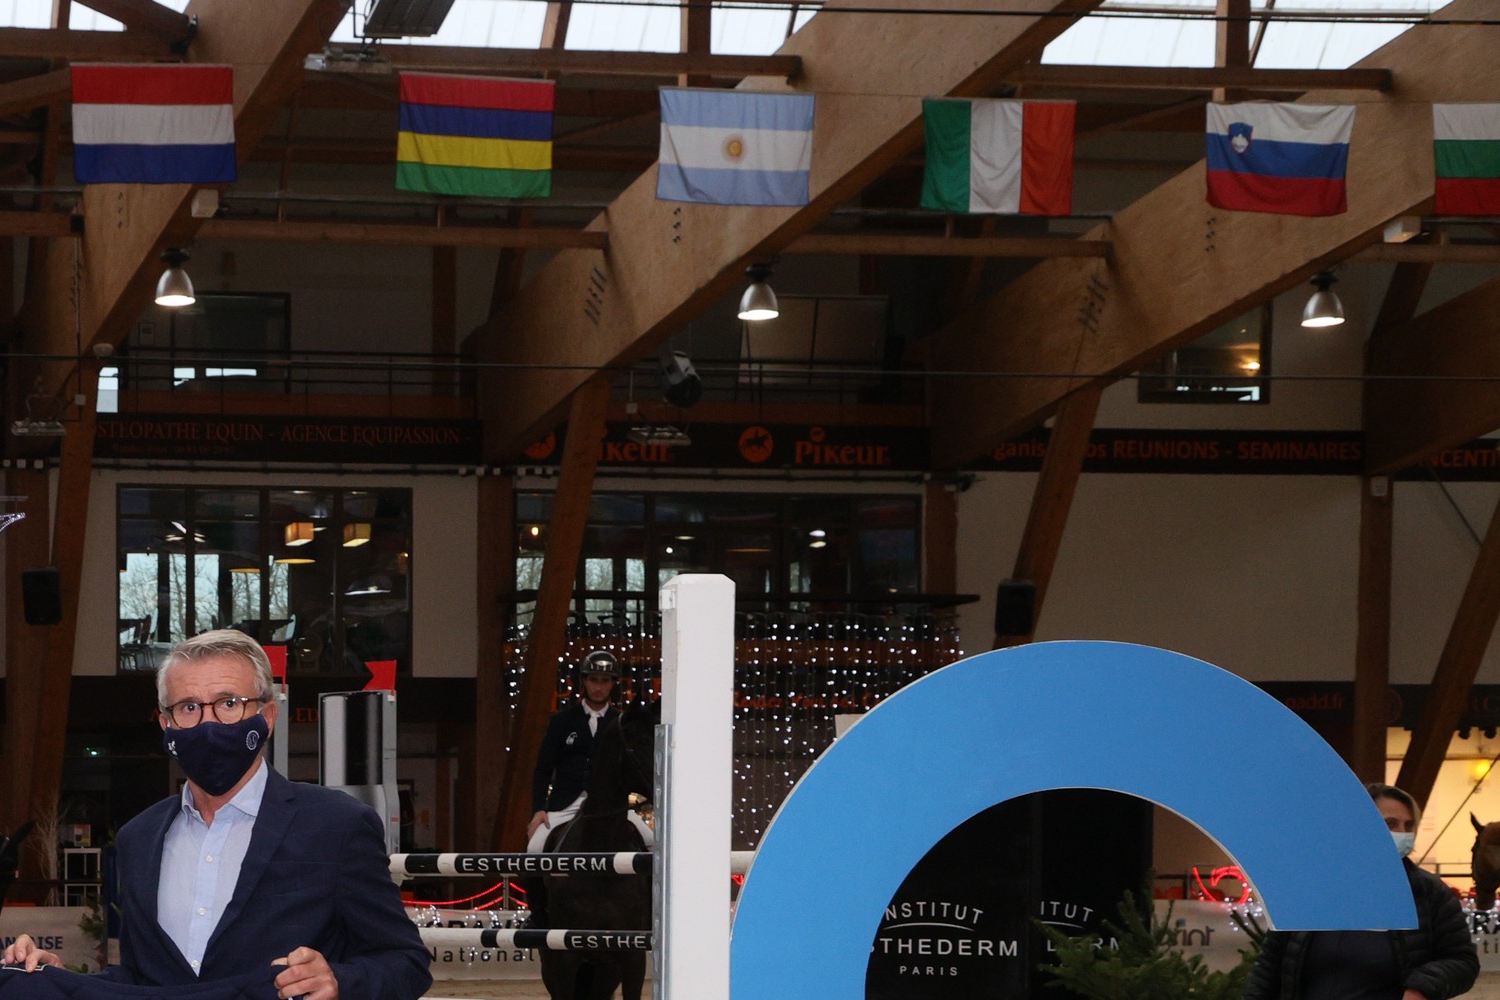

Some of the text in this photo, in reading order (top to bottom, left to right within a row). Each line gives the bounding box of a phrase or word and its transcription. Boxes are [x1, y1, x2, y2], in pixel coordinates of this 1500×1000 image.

[95, 421, 200, 441] STEOPATHE
[461, 856, 608, 872] ESTHEDERM
[884, 901, 984, 925] NSTITUT
[1039, 900, 1095, 923] ITUT
[570, 935, 648, 949] ESTHE
[874, 937, 1019, 957] THEDERM
[899, 965, 959, 977] PARIS
